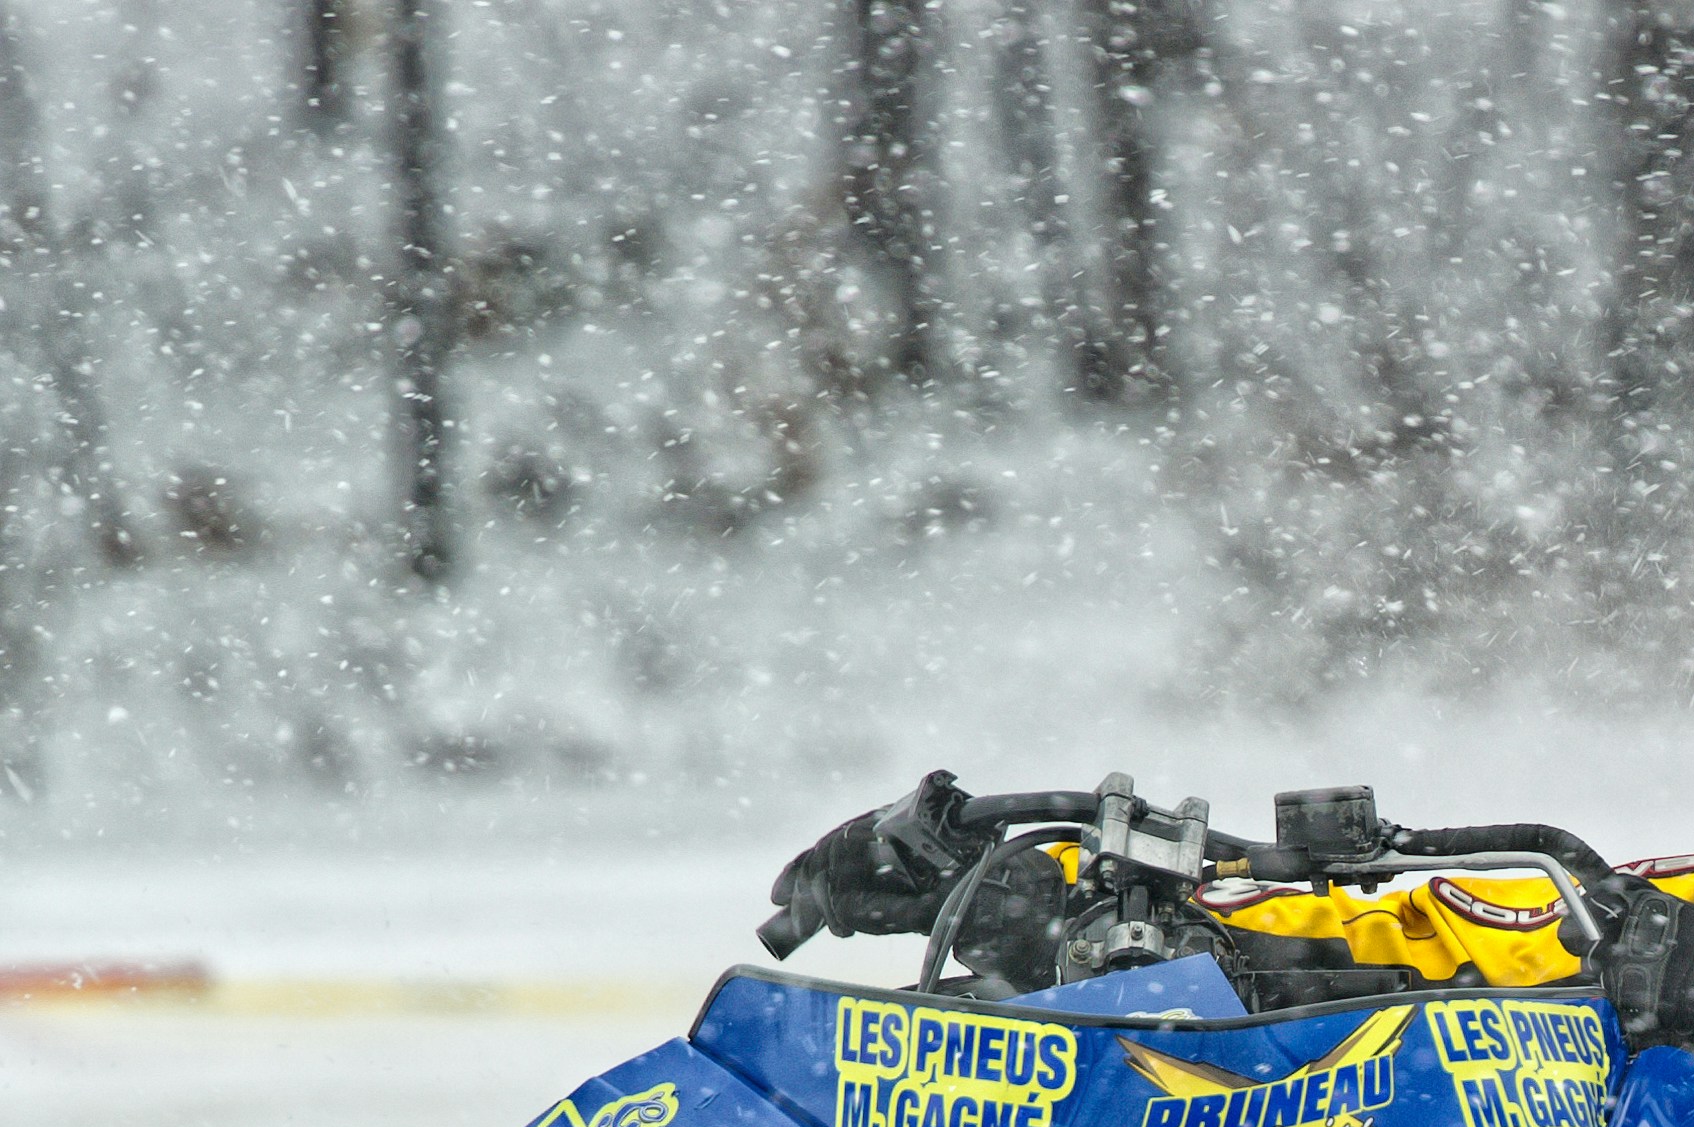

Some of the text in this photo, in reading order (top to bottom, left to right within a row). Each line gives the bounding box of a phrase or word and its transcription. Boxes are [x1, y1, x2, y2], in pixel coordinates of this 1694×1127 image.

[840, 1007, 1070, 1090] LES PNEUS
[1433, 1008, 1605, 1069] LES PNEUS
